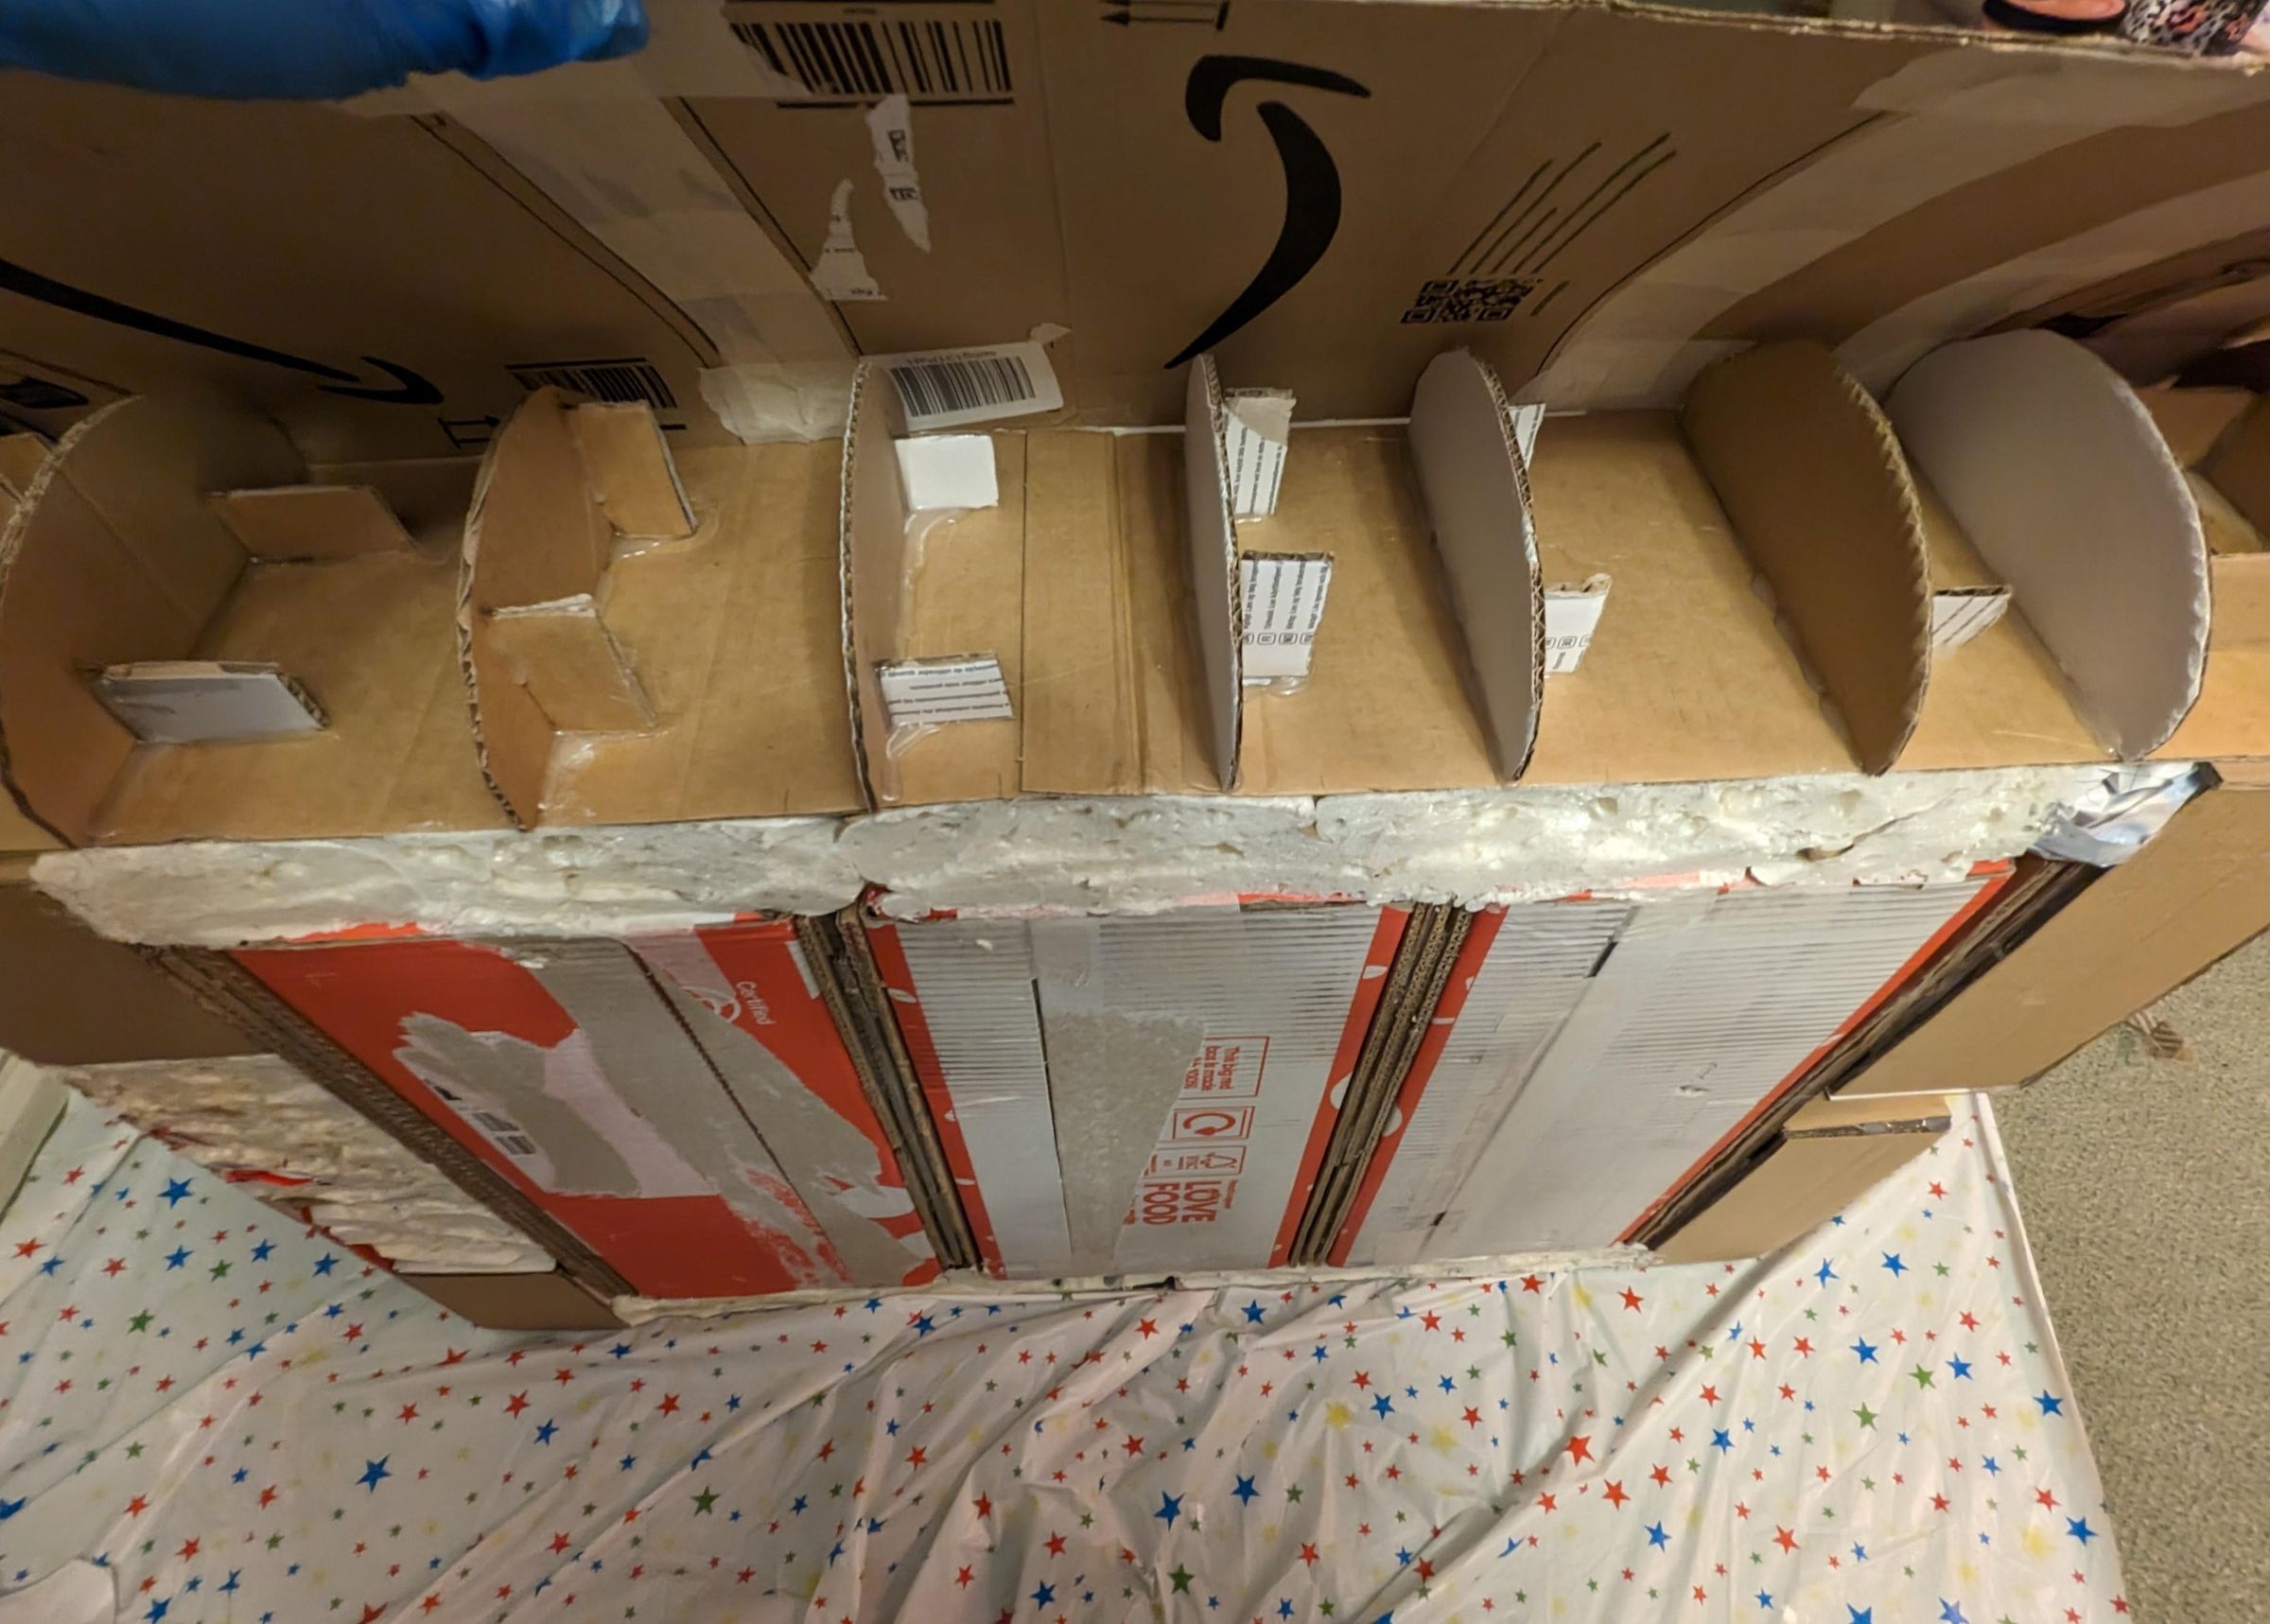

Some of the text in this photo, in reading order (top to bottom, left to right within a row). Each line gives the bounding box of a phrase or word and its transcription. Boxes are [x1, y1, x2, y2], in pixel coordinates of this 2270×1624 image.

[736, 980, 777, 1025] Certified
[1143, 1182, 1180, 1226] FOOD
[1181, 1180, 1222, 1223] LOVE
